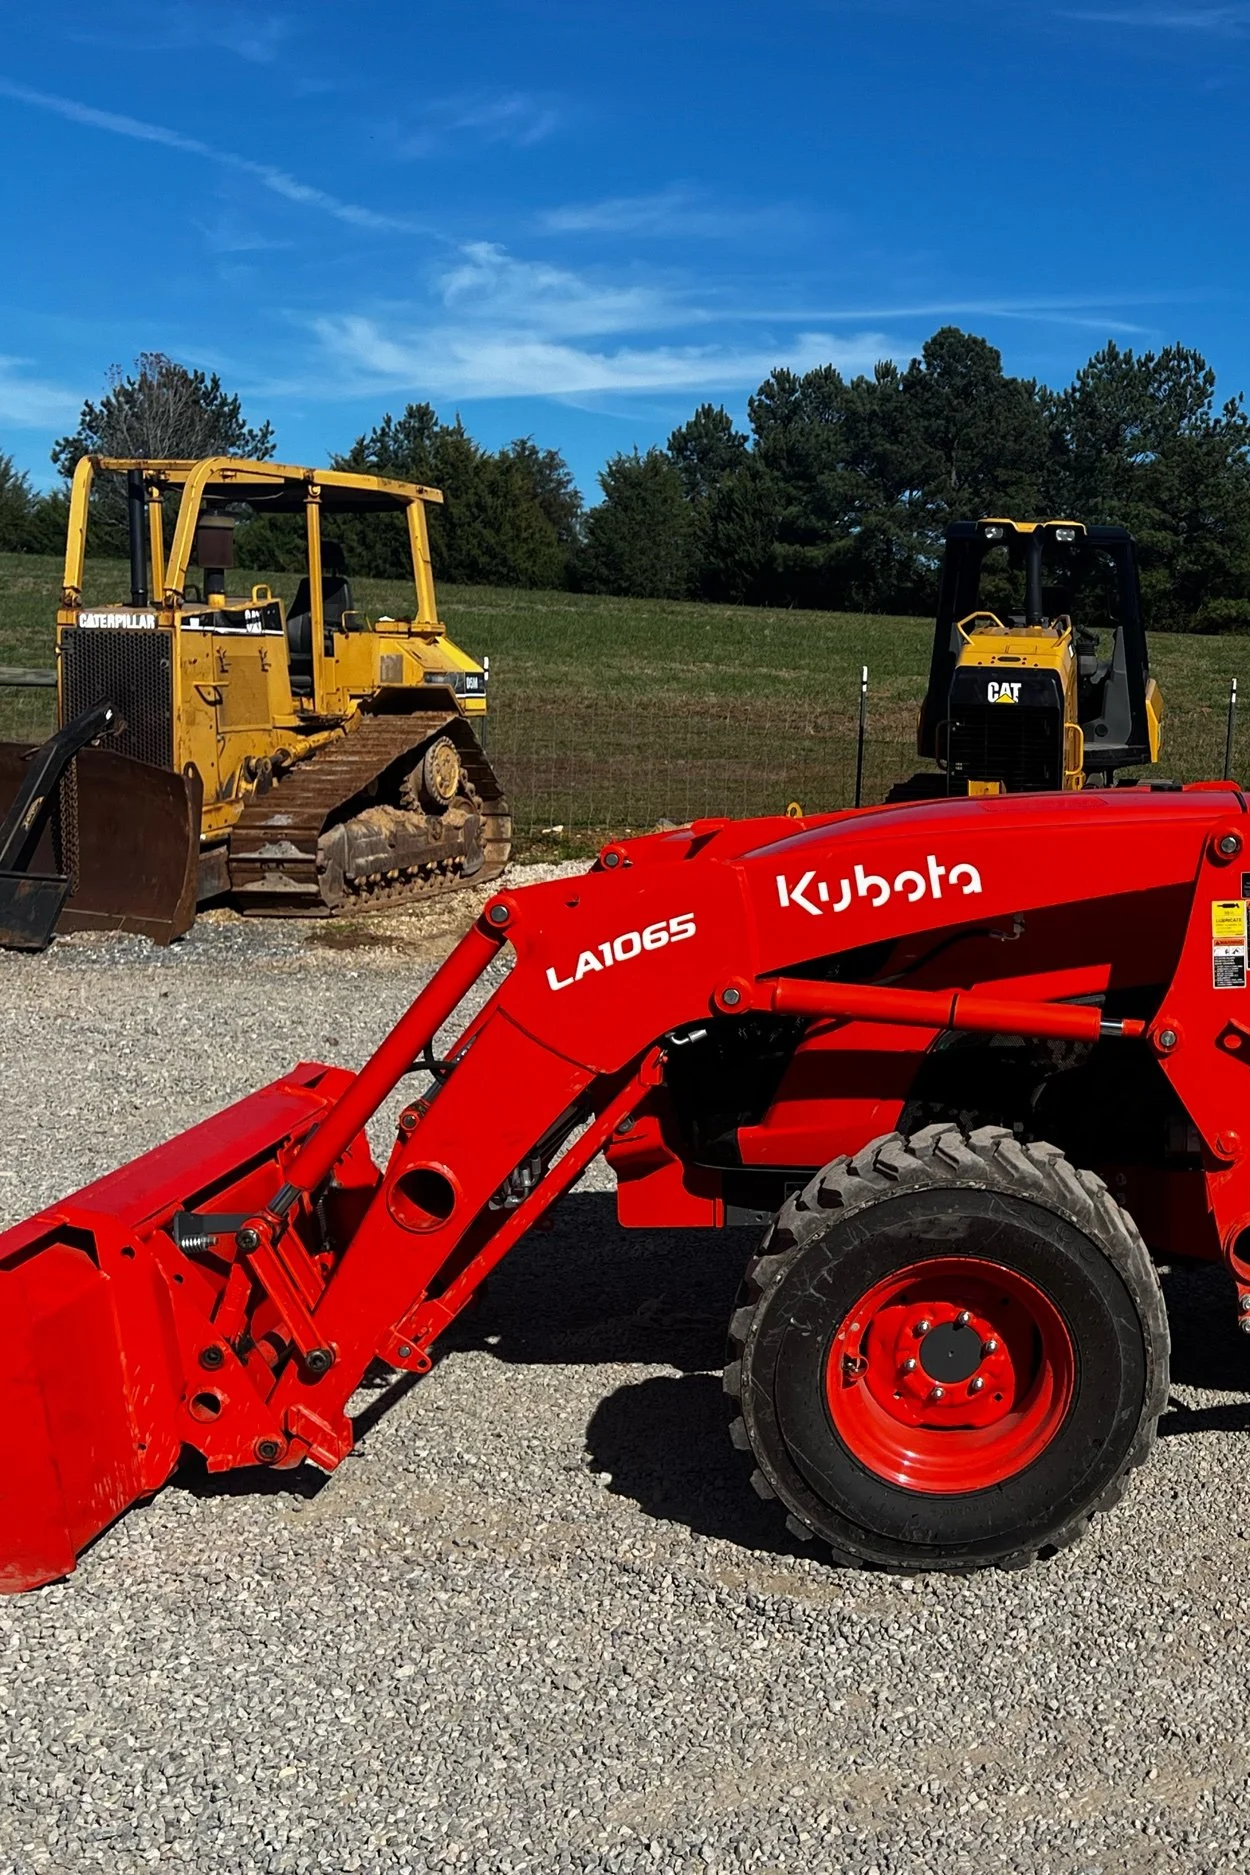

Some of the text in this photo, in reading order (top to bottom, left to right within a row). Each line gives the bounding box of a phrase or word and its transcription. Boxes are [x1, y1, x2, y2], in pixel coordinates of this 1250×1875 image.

[78, 613, 155, 629] CATERPILLAR
[987, 682, 1022, 703] CAT
[776, 854, 983, 915] Kubota
[546, 912, 697, 991] LA1065
